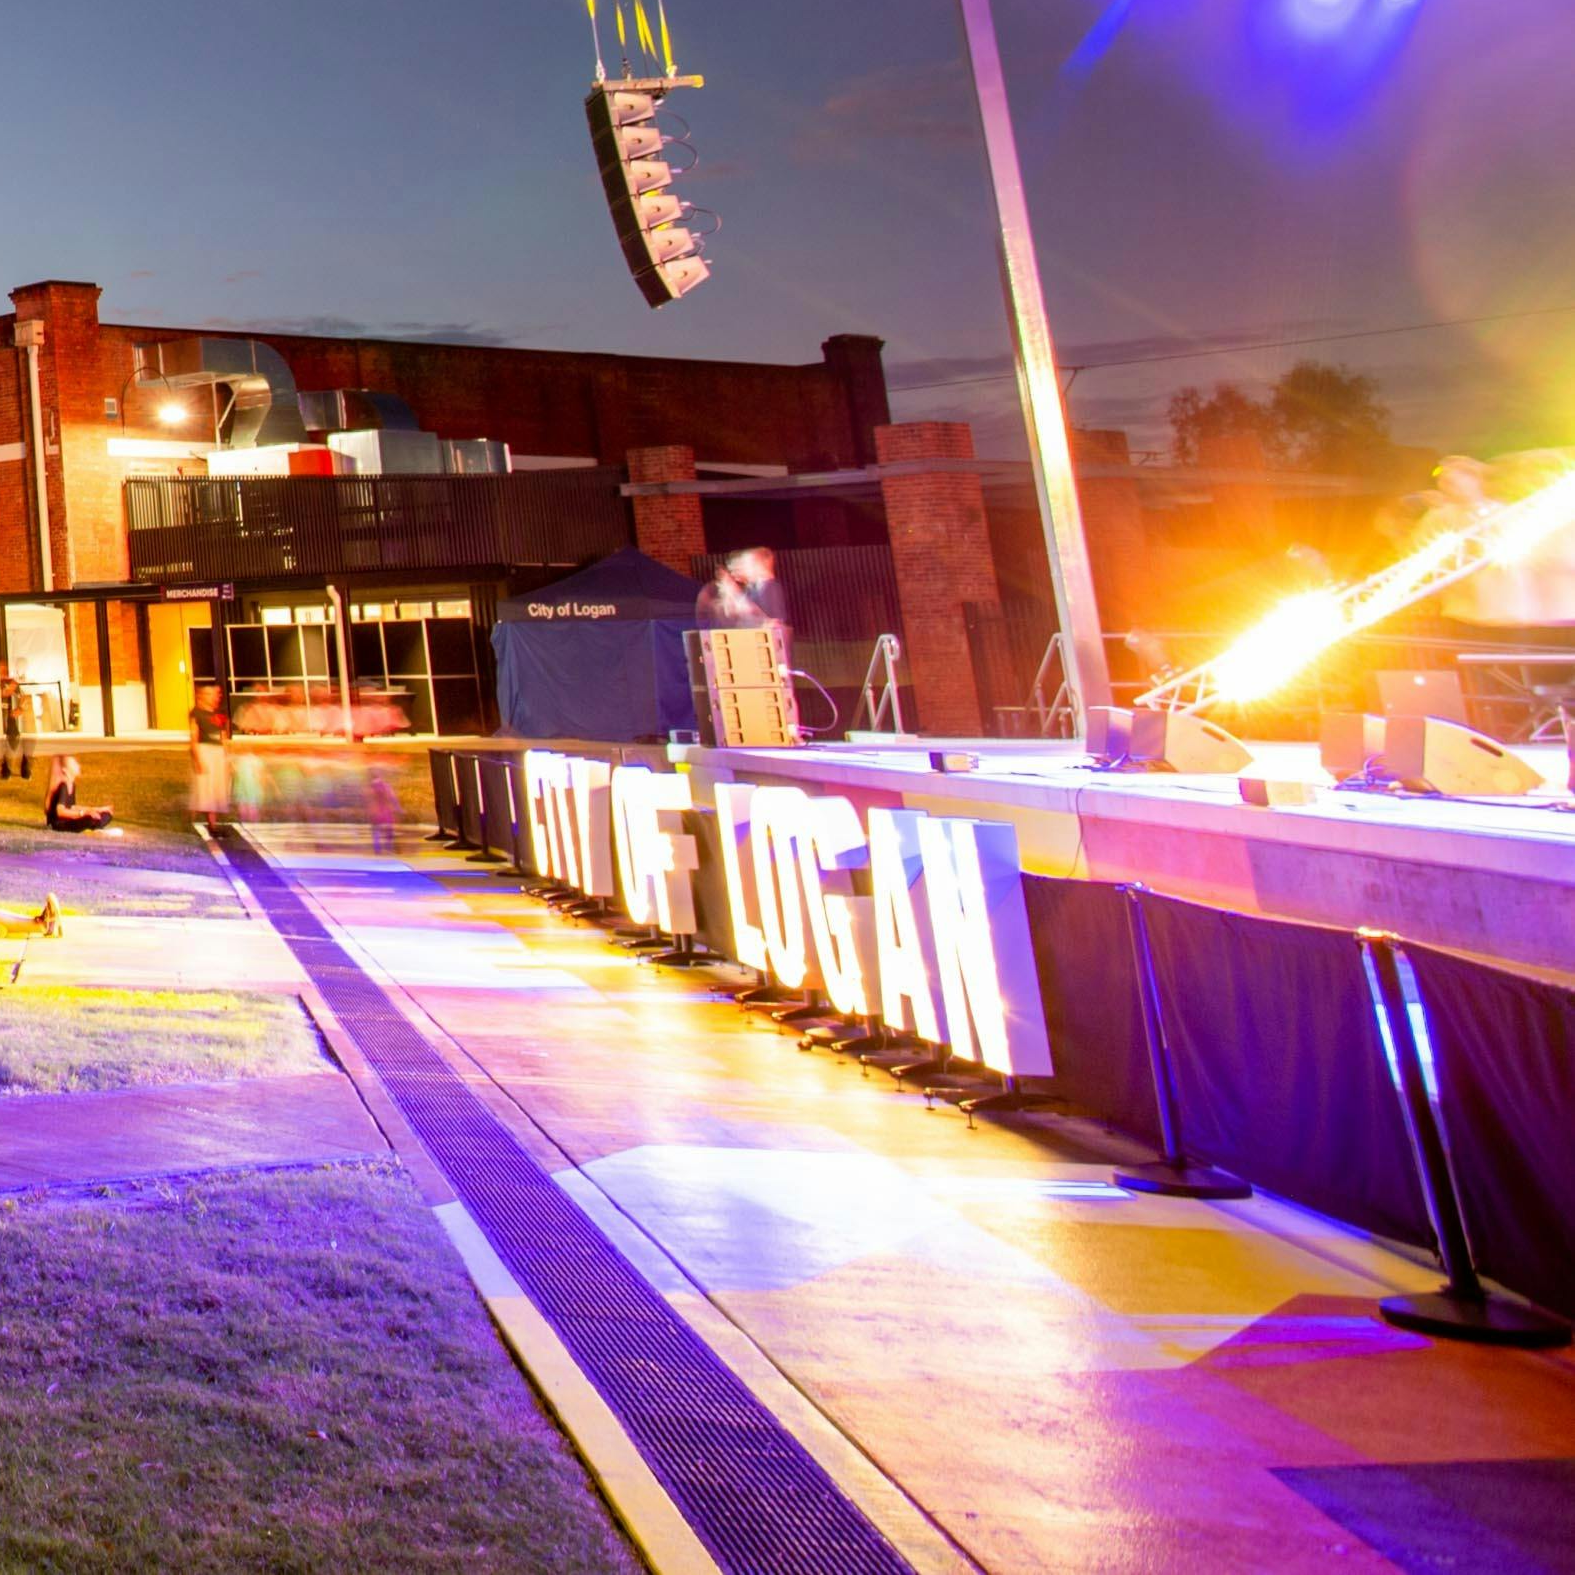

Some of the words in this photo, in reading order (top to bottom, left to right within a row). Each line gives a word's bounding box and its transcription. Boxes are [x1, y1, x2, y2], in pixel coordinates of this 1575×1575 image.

[165, 587, 219, 599] MERCHANDISE
[527, 602, 554, 620] City
[556, 602, 571, 617] of
[572, 602, 617, 619] Logan
[611, 763, 699, 934] OF
[714, 783, 1041, 1077] LOGAN
